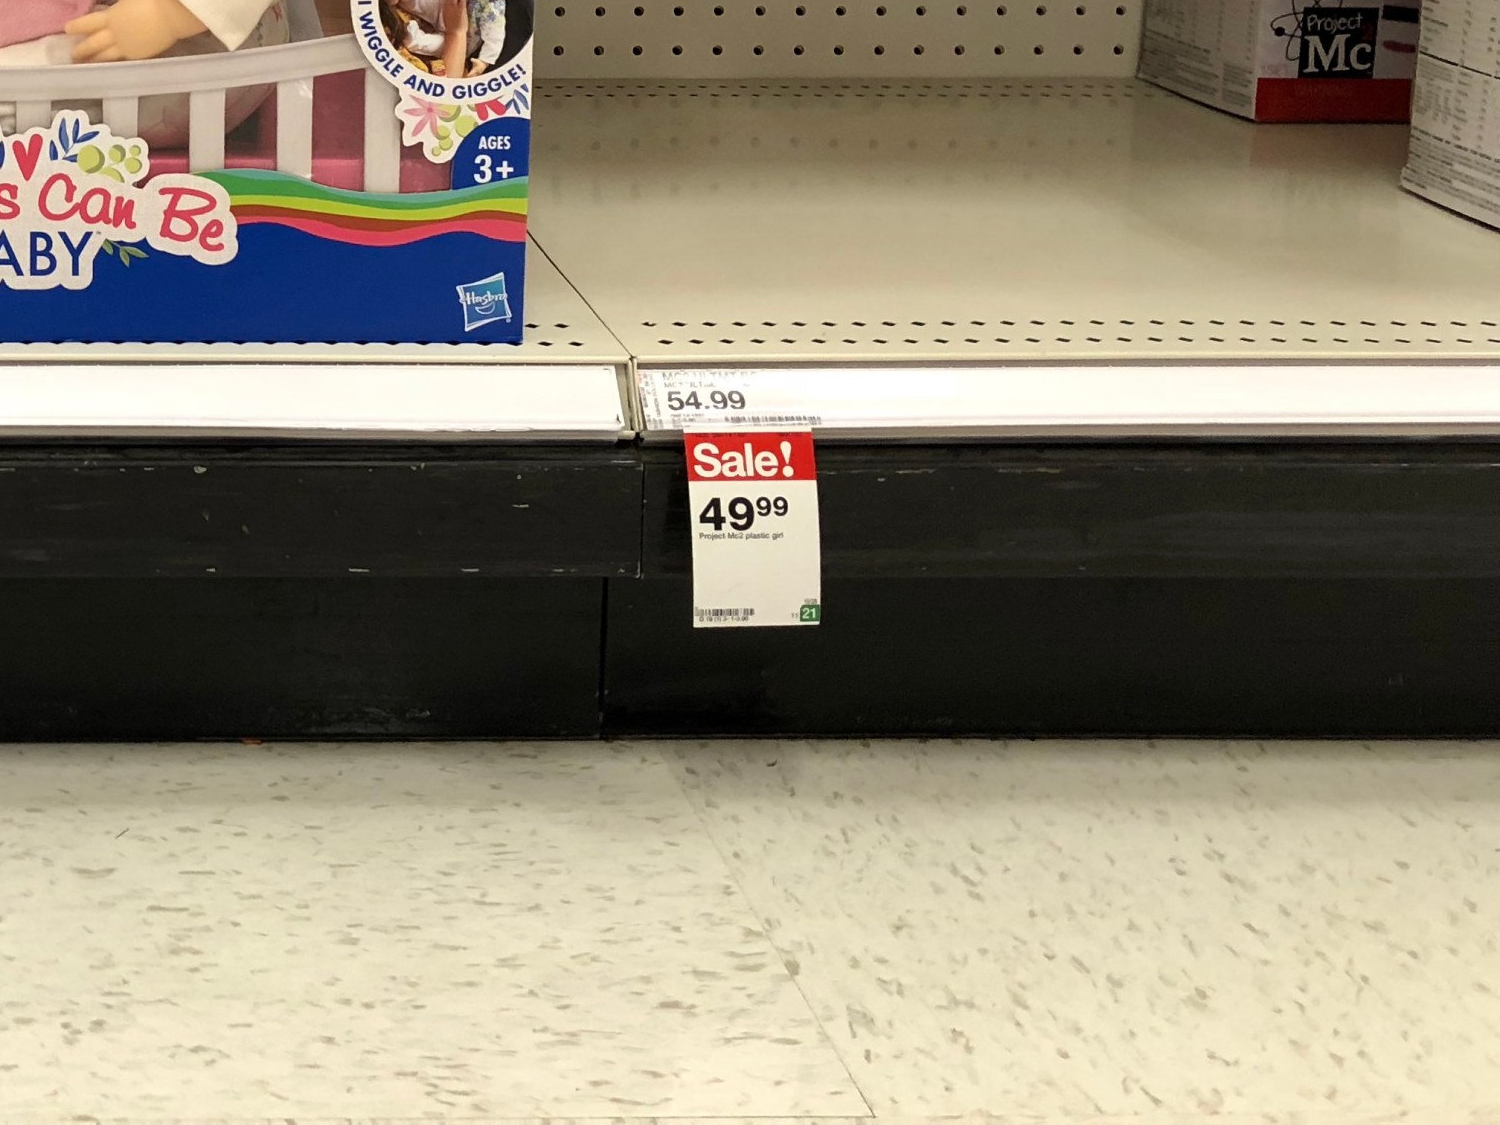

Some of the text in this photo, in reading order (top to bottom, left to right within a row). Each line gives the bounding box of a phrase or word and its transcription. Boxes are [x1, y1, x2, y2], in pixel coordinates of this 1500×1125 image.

[1302, 33, 1372, 73] Mc
[478, 136, 512, 150] AGES
[473, 154, 514, 184] 3+
[38, 172, 137, 230] Can
[158, 185, 226, 253] Be
[667, 390, 746, 411] 54.99
[693, 441, 795, 478] Sale!
[699, 531, 784, 541] Project Mc2 plastic girl
[802, 607, 817, 619] 21
